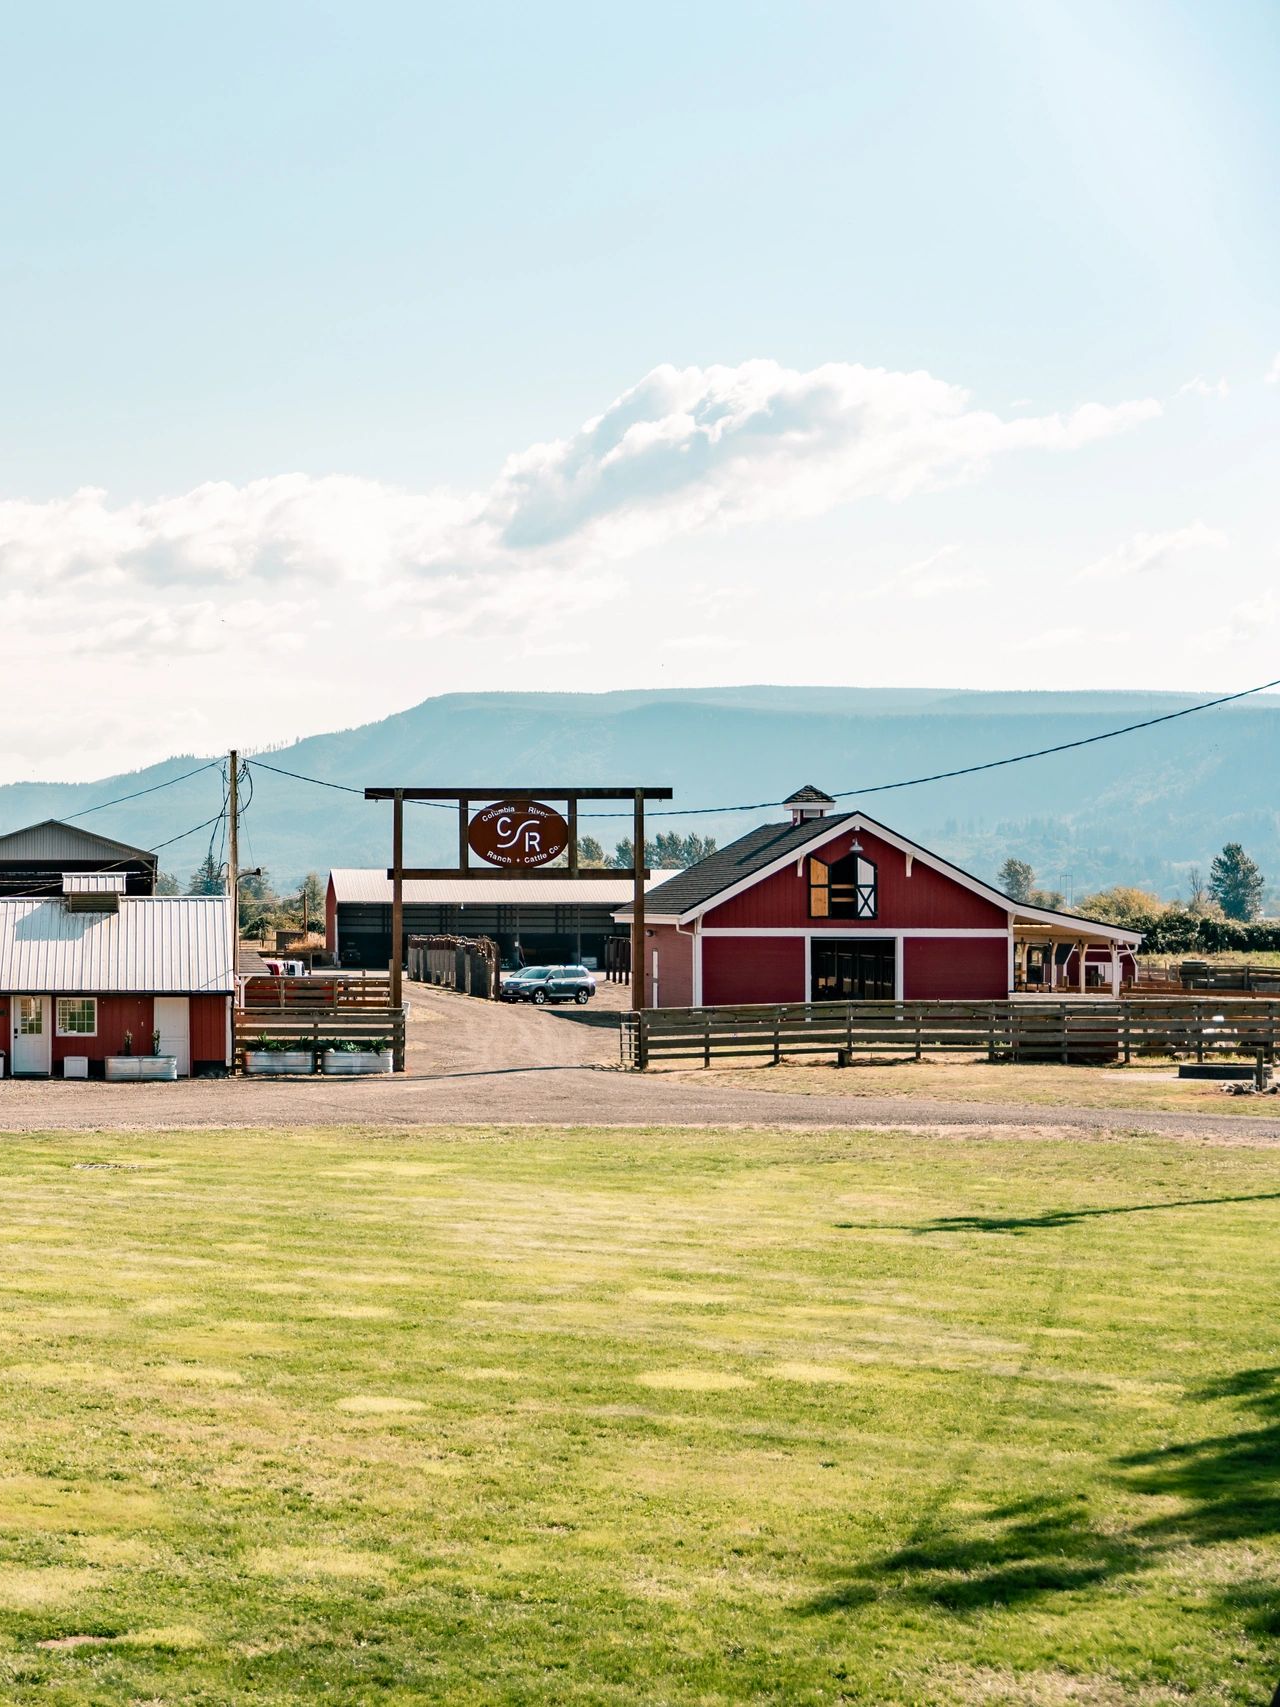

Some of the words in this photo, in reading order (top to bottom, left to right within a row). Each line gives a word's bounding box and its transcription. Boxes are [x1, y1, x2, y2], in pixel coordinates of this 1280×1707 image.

[482, 806, 515, 822] Columbia
[528, 806, 549, 819] River
[487, 850, 512, 863] Ranch
[524, 853, 547, 863] Cattle
